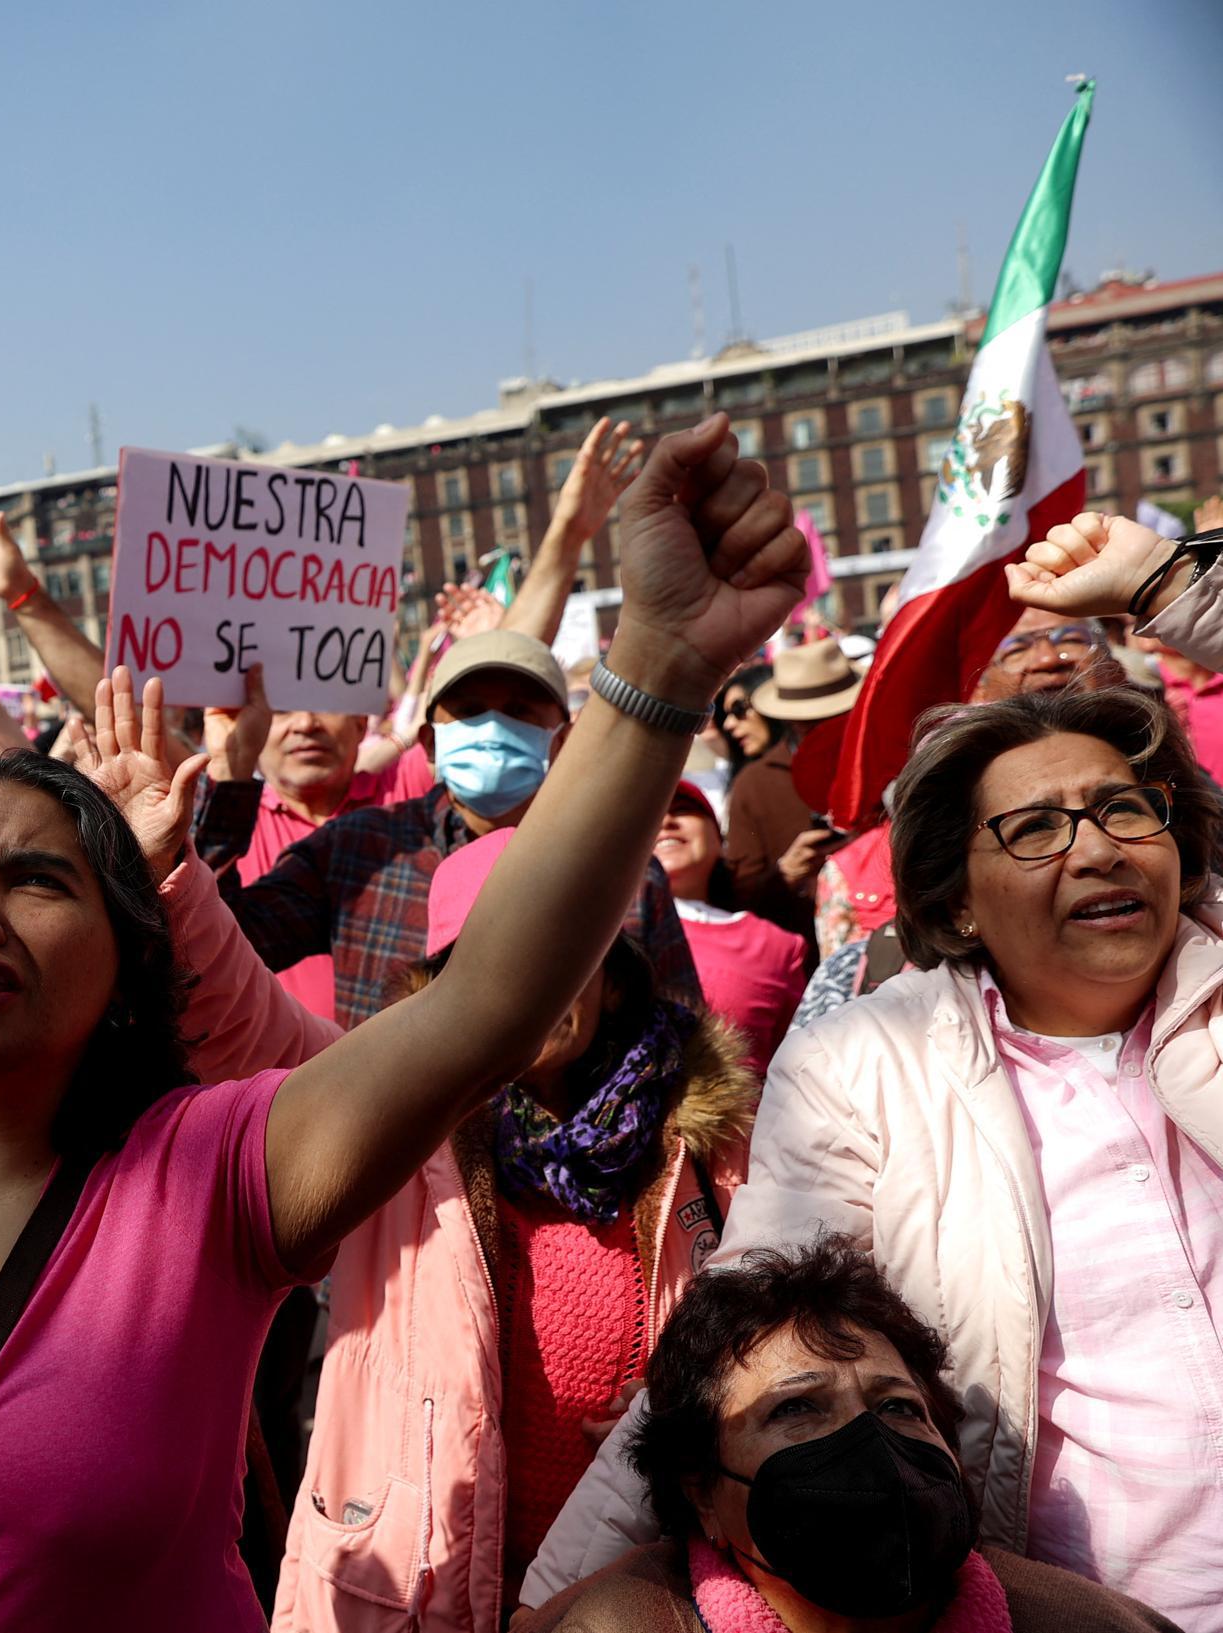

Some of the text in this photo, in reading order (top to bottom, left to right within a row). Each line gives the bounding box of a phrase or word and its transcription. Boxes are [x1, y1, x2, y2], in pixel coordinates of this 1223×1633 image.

[166, 462, 365, 548] NUESTRA
[145, 531, 397, 613] DEMOCRACIA
[117, 613, 385, 688] NO SE TOCA
